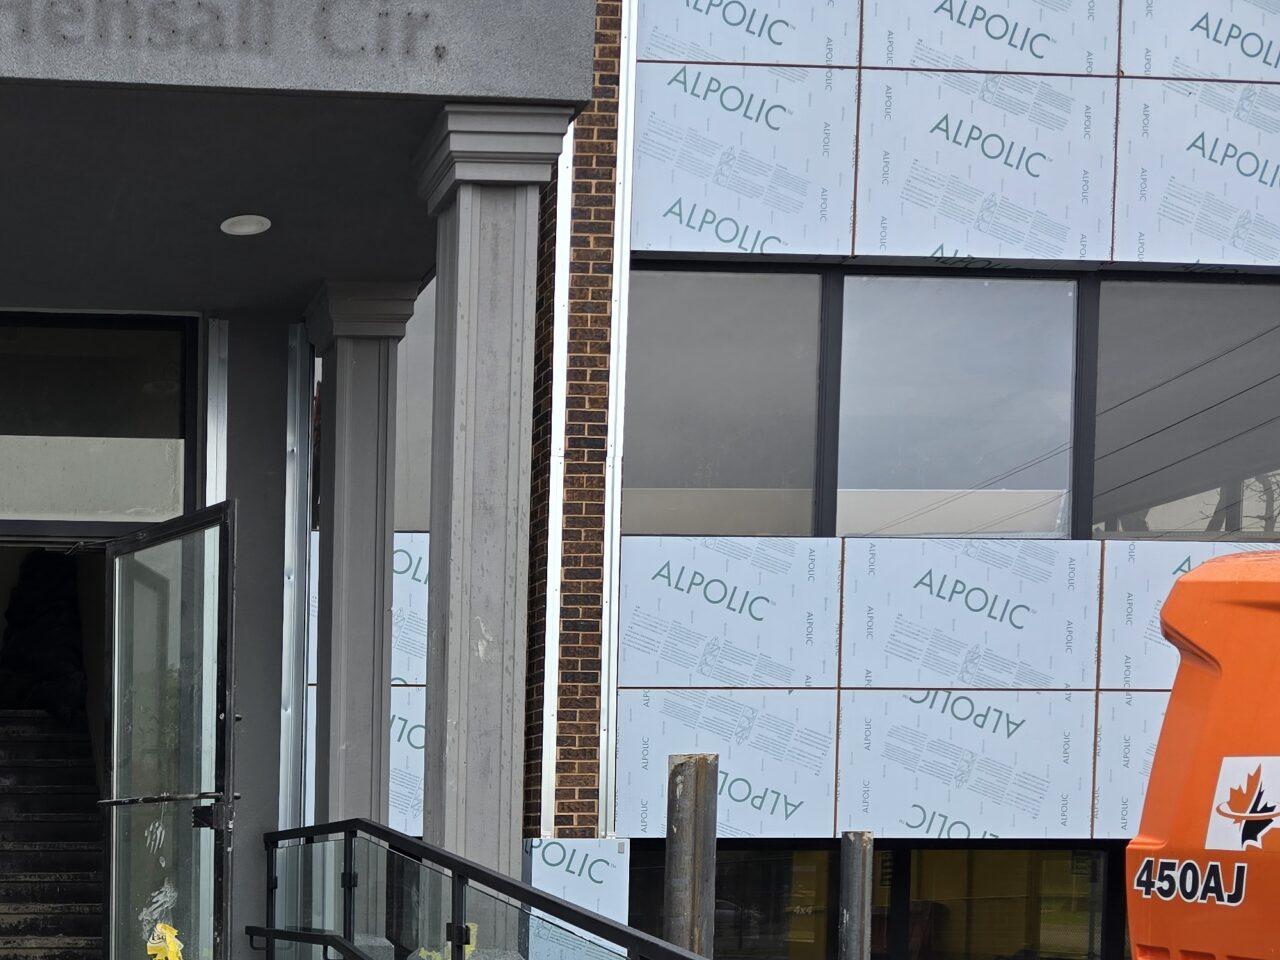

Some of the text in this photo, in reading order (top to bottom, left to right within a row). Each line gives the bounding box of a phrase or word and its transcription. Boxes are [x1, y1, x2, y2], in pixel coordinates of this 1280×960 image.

[686, 0, 789, 46] LPOLIC
[934, 0, 1051, 59] ALPOLIC
[1190, 12, 1280, 68] ALPOLI
[667, 65, 787, 131] ALPOLIC
[929, 113, 1047, 178] ALPOLIC
[1186, 131, 1280, 188] ALPOLI
[663, 197, 782, 254] ALPOLIC
[651, 560, 770, 622] ALPOLIC
[913, 568, 1030, 630] ALPOLIC
[718, 770, 804, 821] ALPOL
[1134, 857, 1248, 907] 450AJ
